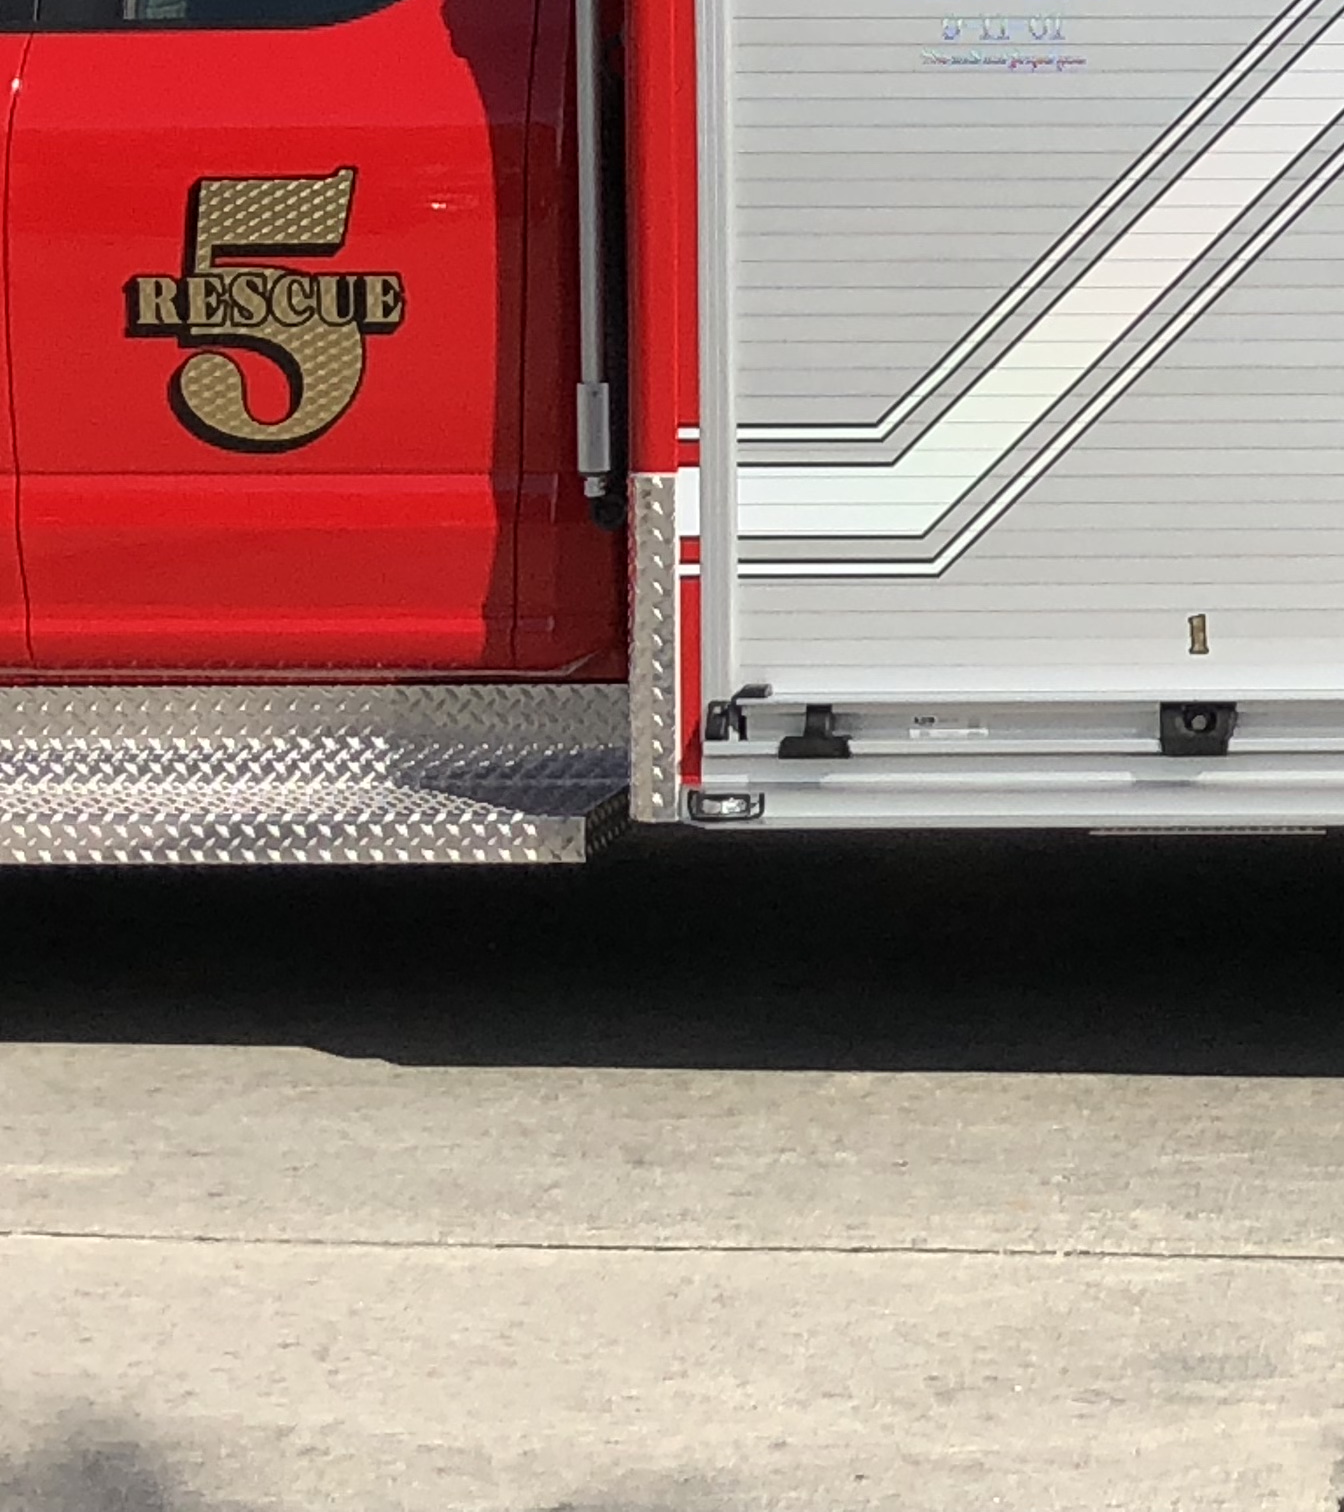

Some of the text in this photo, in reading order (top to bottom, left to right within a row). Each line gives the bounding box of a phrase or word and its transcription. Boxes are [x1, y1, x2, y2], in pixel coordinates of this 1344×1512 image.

[124, 272, 406, 338] RESCUE
[167, 165, 366, 455] 5
[1188, 613, 1210, 655] 1
